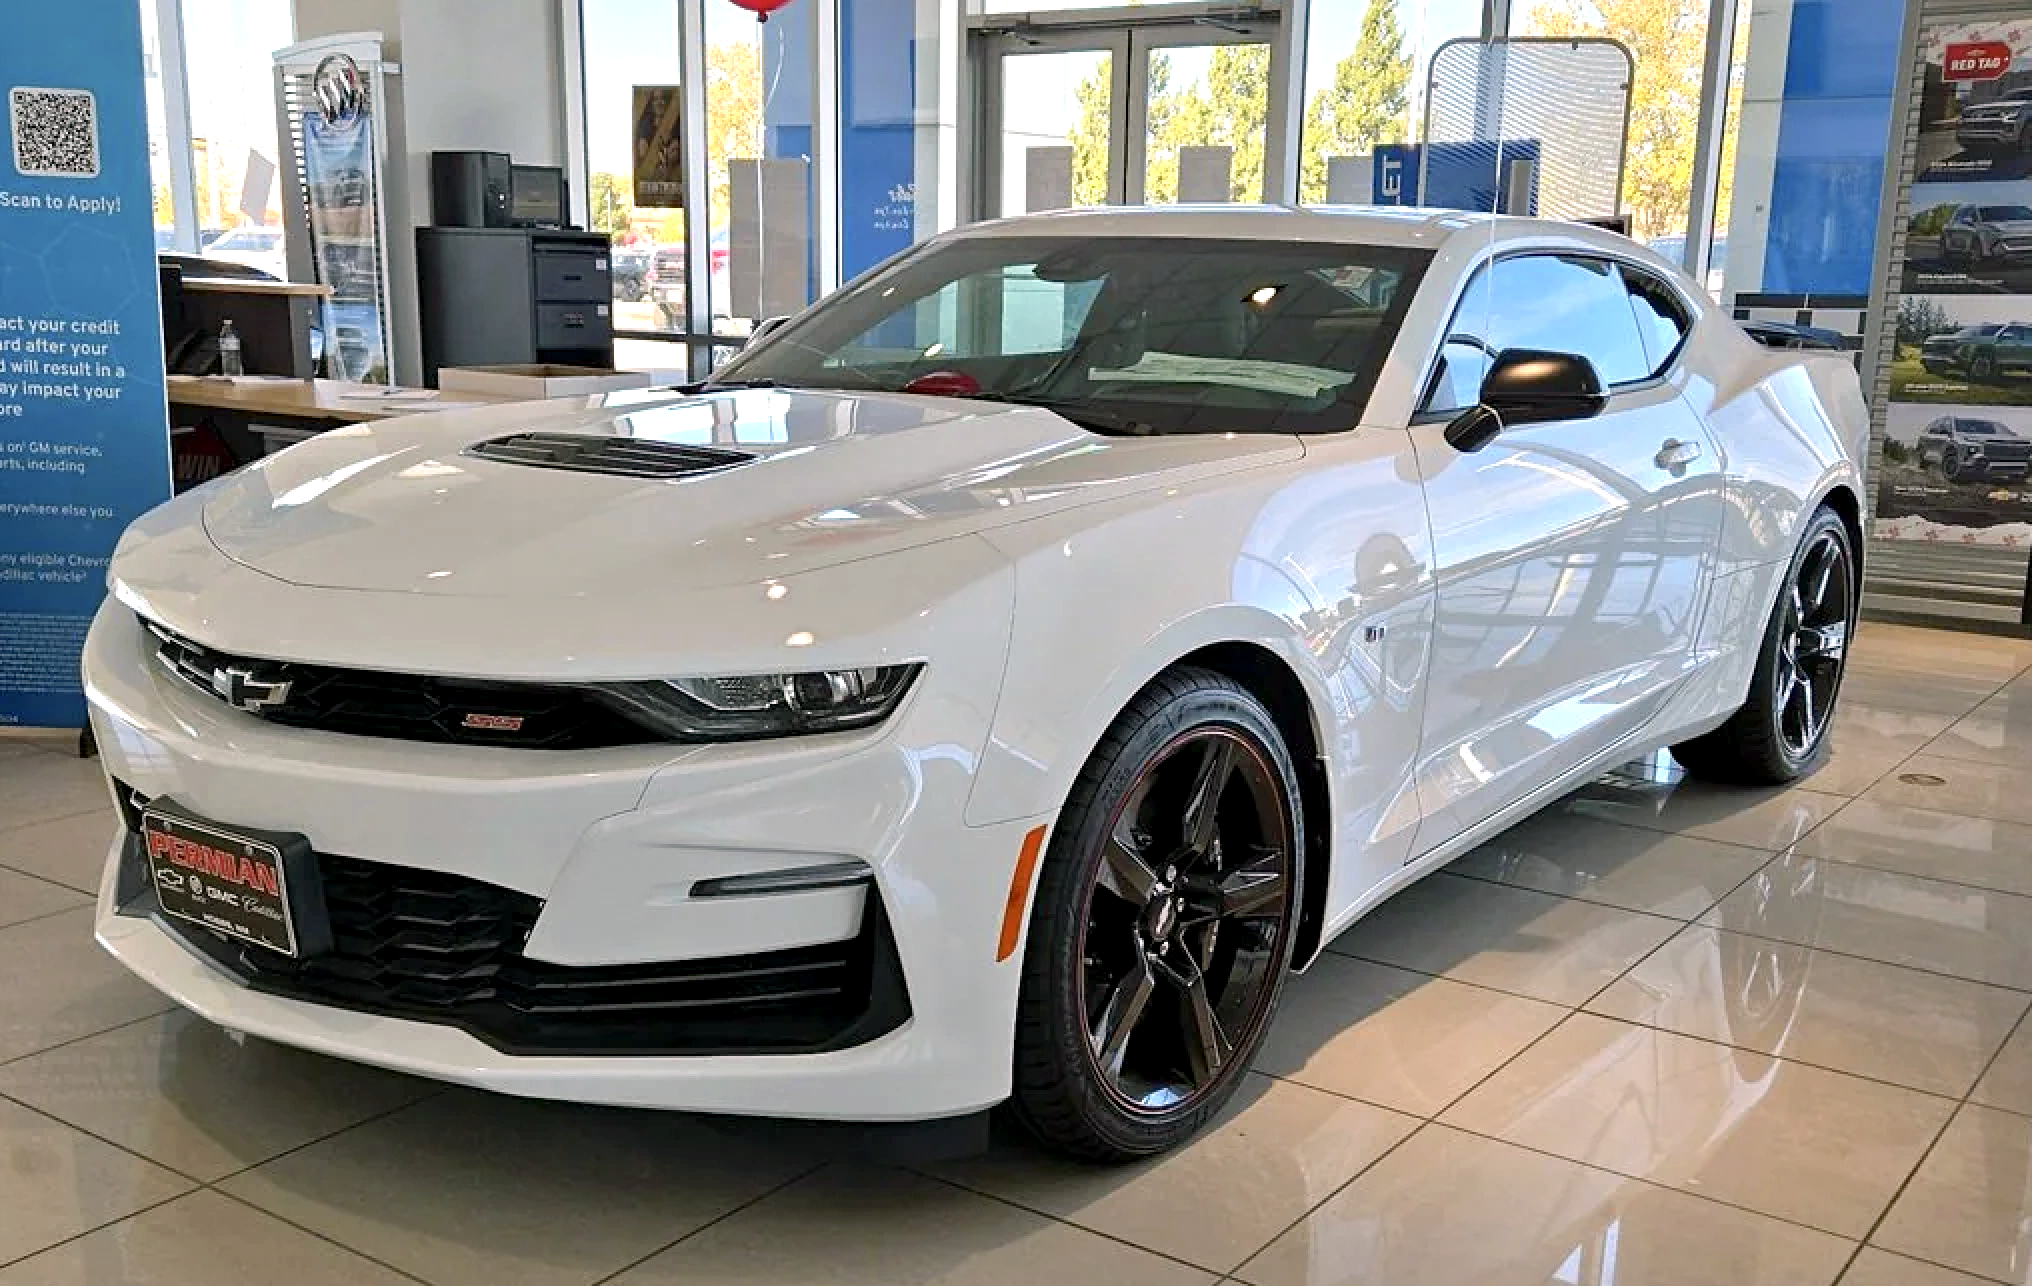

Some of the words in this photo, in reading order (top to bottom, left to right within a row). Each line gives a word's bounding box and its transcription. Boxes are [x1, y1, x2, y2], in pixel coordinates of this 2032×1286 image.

[1949, 58, 1977, 71] RED
[0, 191, 41, 208] Scan
[45, 193, 63, 209] to
[67, 195, 121, 217] Apply!
[28, 319, 67, 335] your
[71, 319, 121, 335] credit
[25, 337, 67, 354] after
[70, 343, 109, 358] your
[10, 359, 39, 375] will
[43, 361, 91, 377] result
[95, 362, 111, 377] in
[115, 365, 126, 378] a
[22, 379, 79, 398] impact
[83, 385, 122, 401] your
[29, 441, 50, 454] GM
[27, 459, 85, 475] including
[90, 507, 113, 519] you
[20, 553, 65, 567] eligible
[149, 829, 280, 897] PERMIAN
[205, 884, 241, 908] GMC
